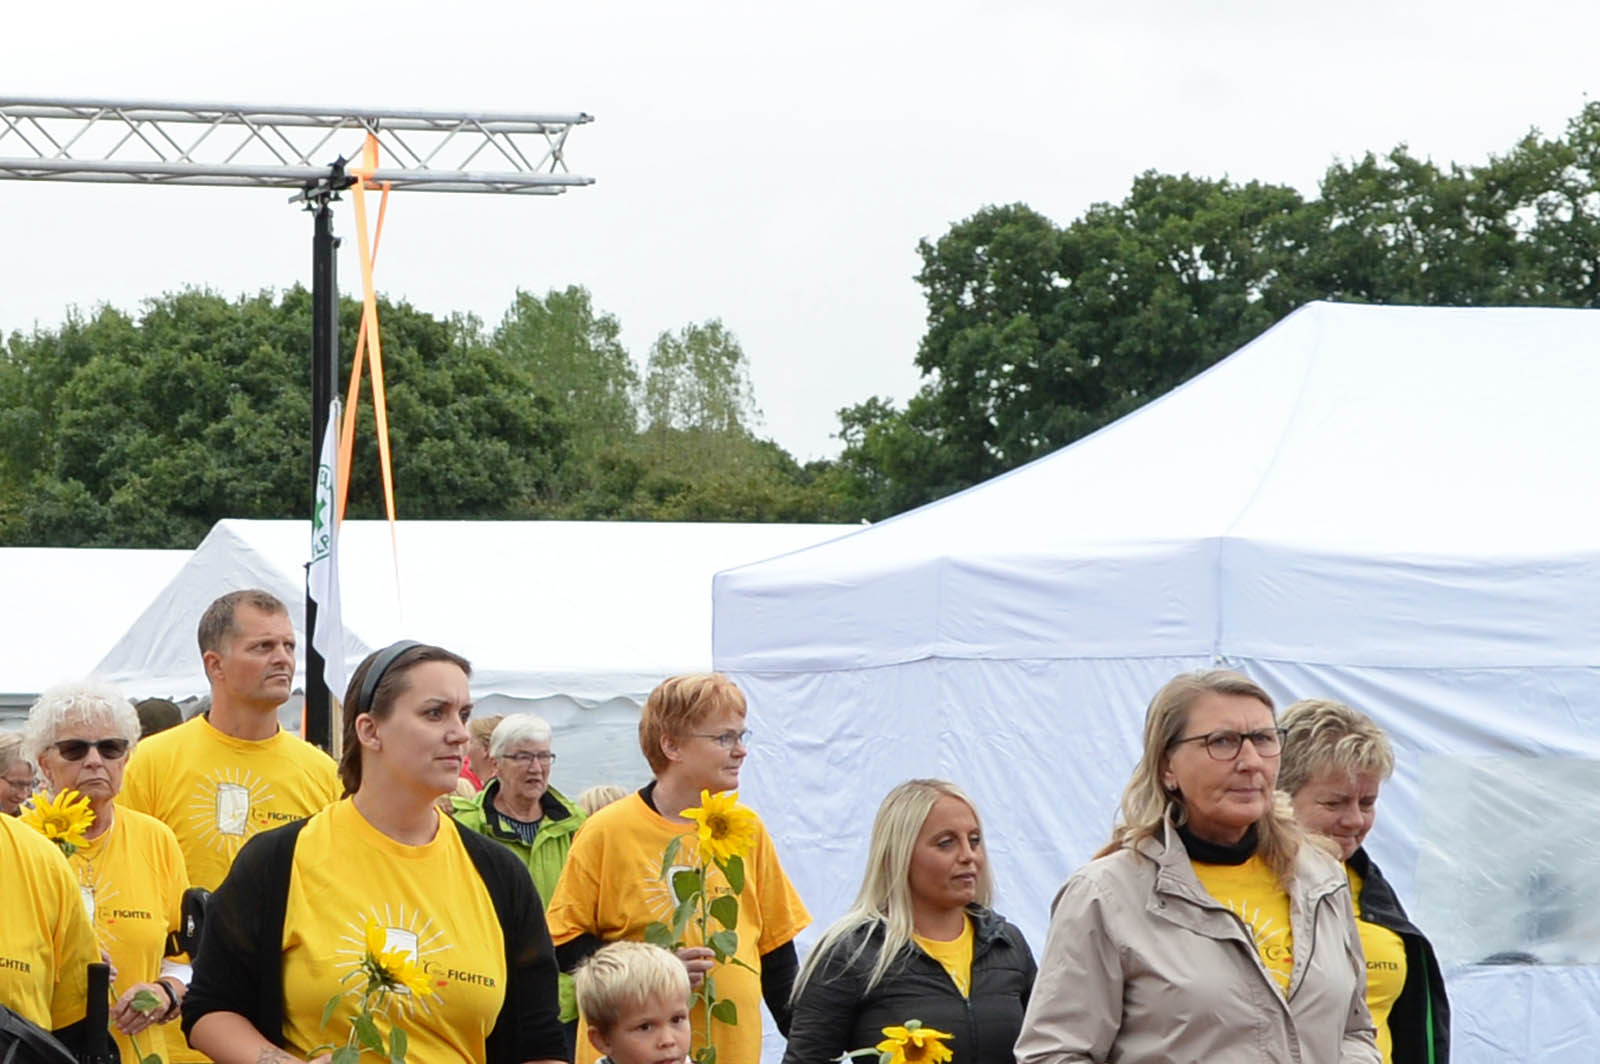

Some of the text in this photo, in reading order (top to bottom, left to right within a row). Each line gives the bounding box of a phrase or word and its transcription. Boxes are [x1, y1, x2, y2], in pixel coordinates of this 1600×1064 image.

[112, 909, 152, 920] FIGHTER
[1366, 961, 1399, 970] GHTER
[447, 968, 496, 988] FIGHTER
